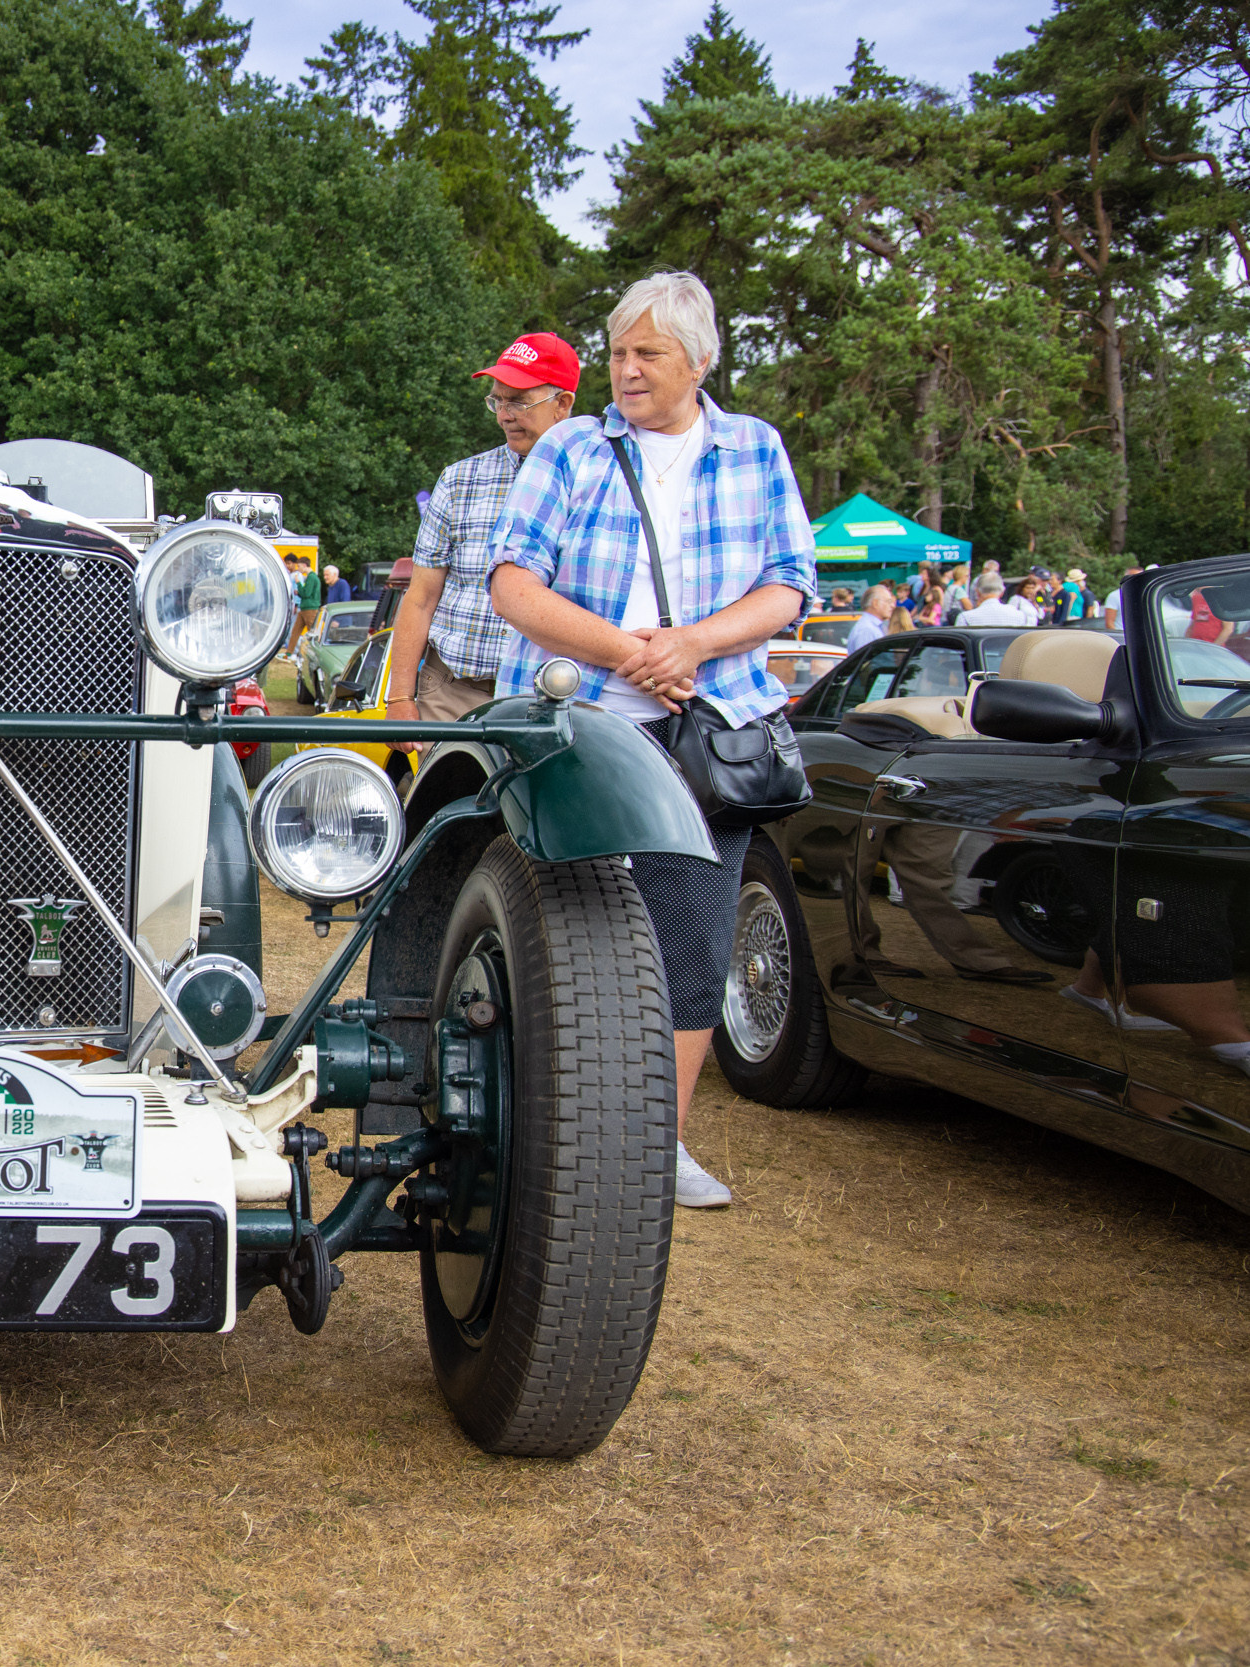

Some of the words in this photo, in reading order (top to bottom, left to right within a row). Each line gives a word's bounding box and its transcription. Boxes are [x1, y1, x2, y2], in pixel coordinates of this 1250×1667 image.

[36, 912, 63, 920] TALBOT
[37, 951, 56, 959] CLUB
[12, 1109, 34, 1121] 20
[12, 1122, 34, 1135] 22
[35, 1226, 177, 1316] 73
